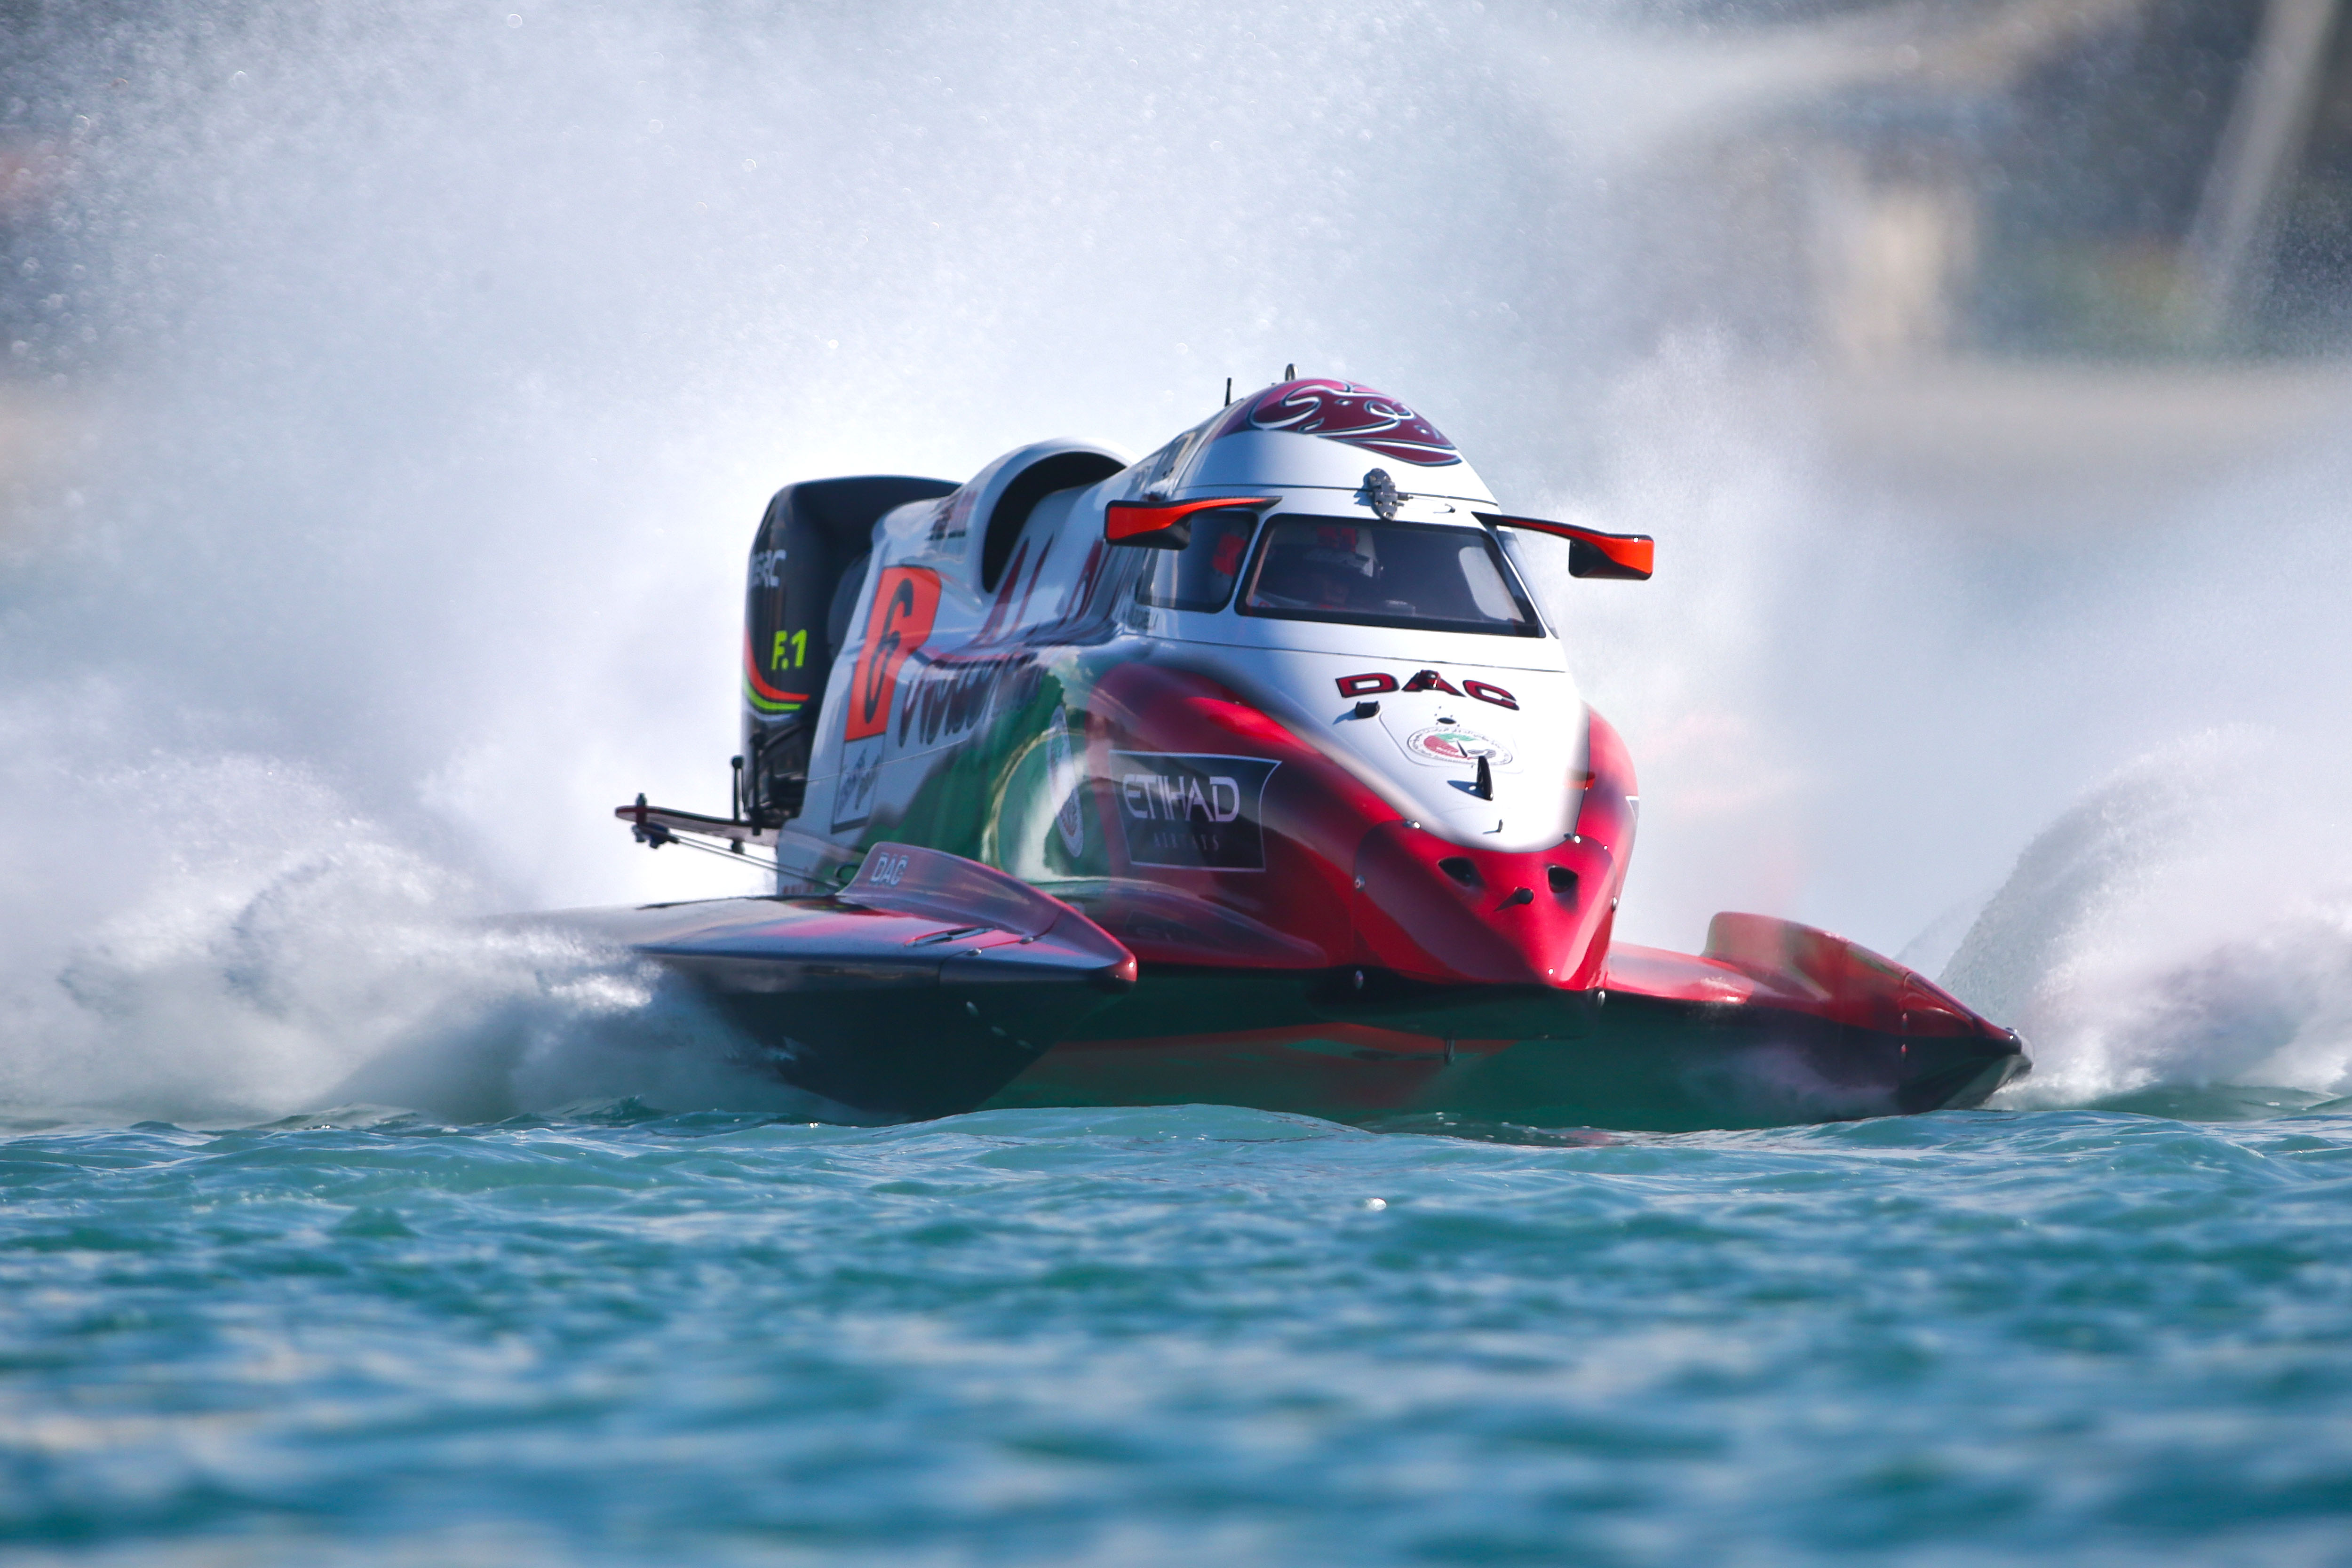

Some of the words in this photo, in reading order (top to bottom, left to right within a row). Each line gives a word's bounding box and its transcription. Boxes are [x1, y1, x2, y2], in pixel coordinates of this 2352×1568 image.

[771, 629, 807, 670] F.1
[865, 577, 914, 724] 6
[1122, 773, 1240, 822] ETIHAD
